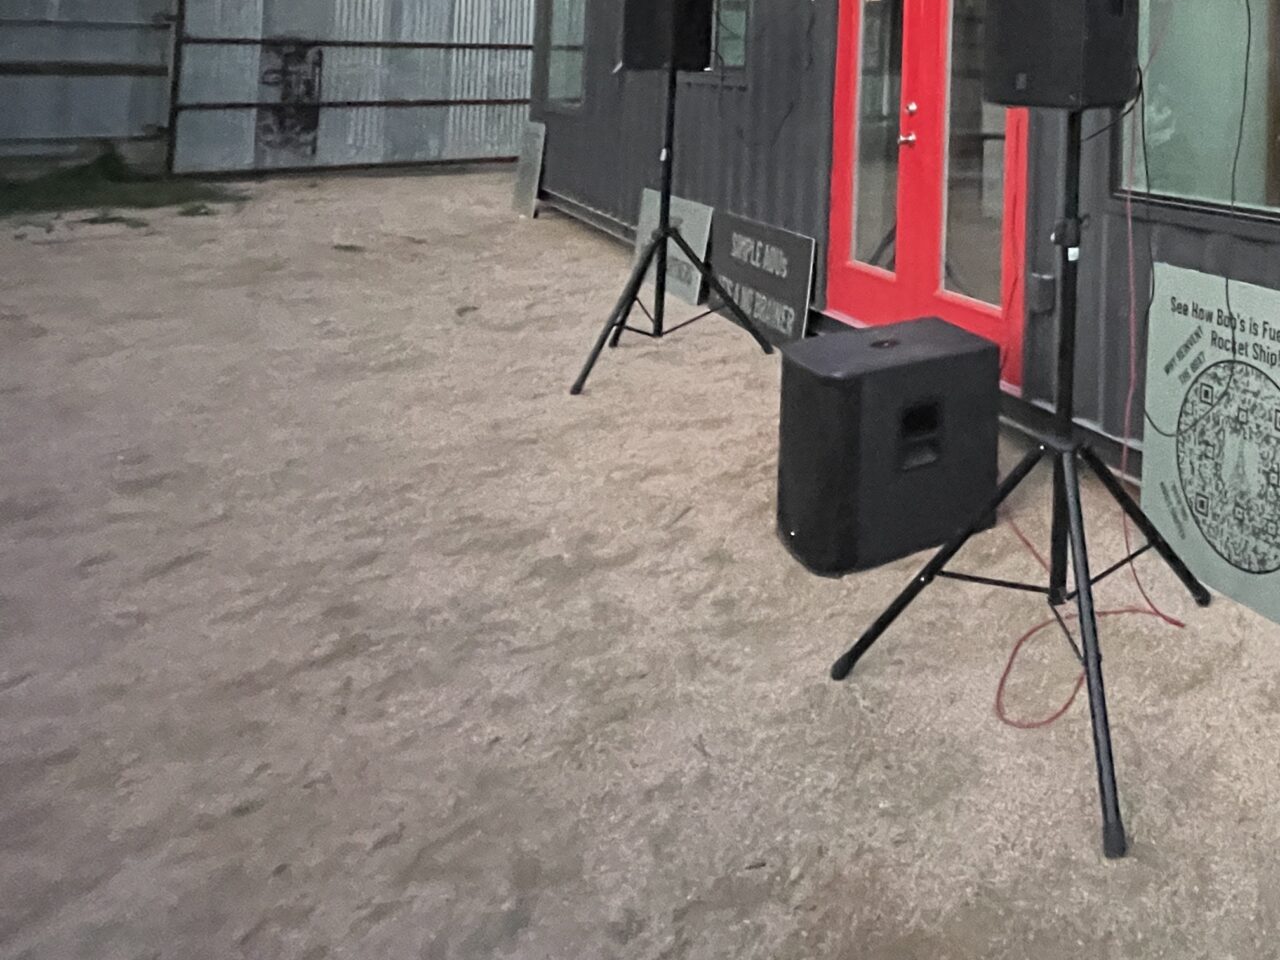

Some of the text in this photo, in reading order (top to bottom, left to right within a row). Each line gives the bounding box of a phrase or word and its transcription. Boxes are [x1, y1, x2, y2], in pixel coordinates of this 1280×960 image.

[1170, 296, 1189, 316] See
[1192, 301, 1214, 324] How
[1249, 317, 1259, 337] is
